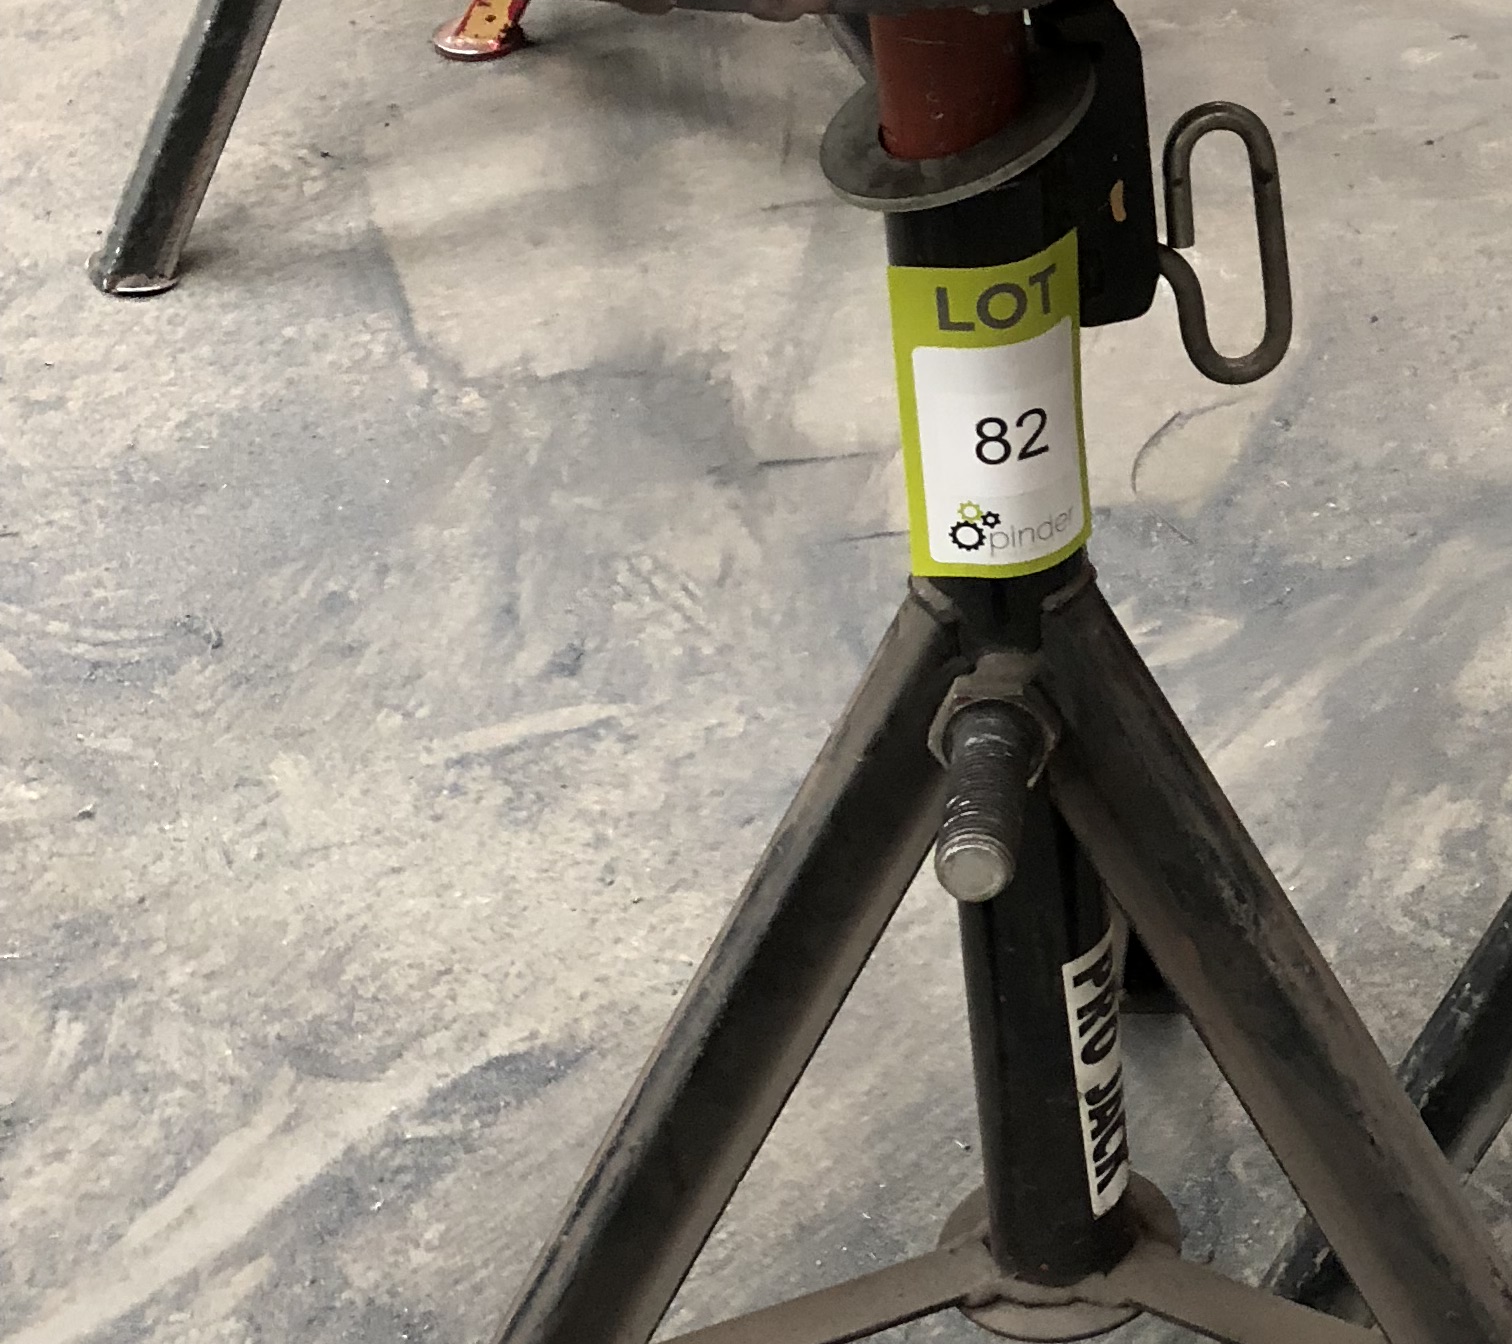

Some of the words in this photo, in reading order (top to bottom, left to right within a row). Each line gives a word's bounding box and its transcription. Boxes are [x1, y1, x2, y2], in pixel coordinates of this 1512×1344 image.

[935, 263, 1056, 332] LOT
[975, 408, 1049, 465] 82
[1072, 942, 1117, 1066] PRO
[1085, 1061, 1129, 1196] JACK
